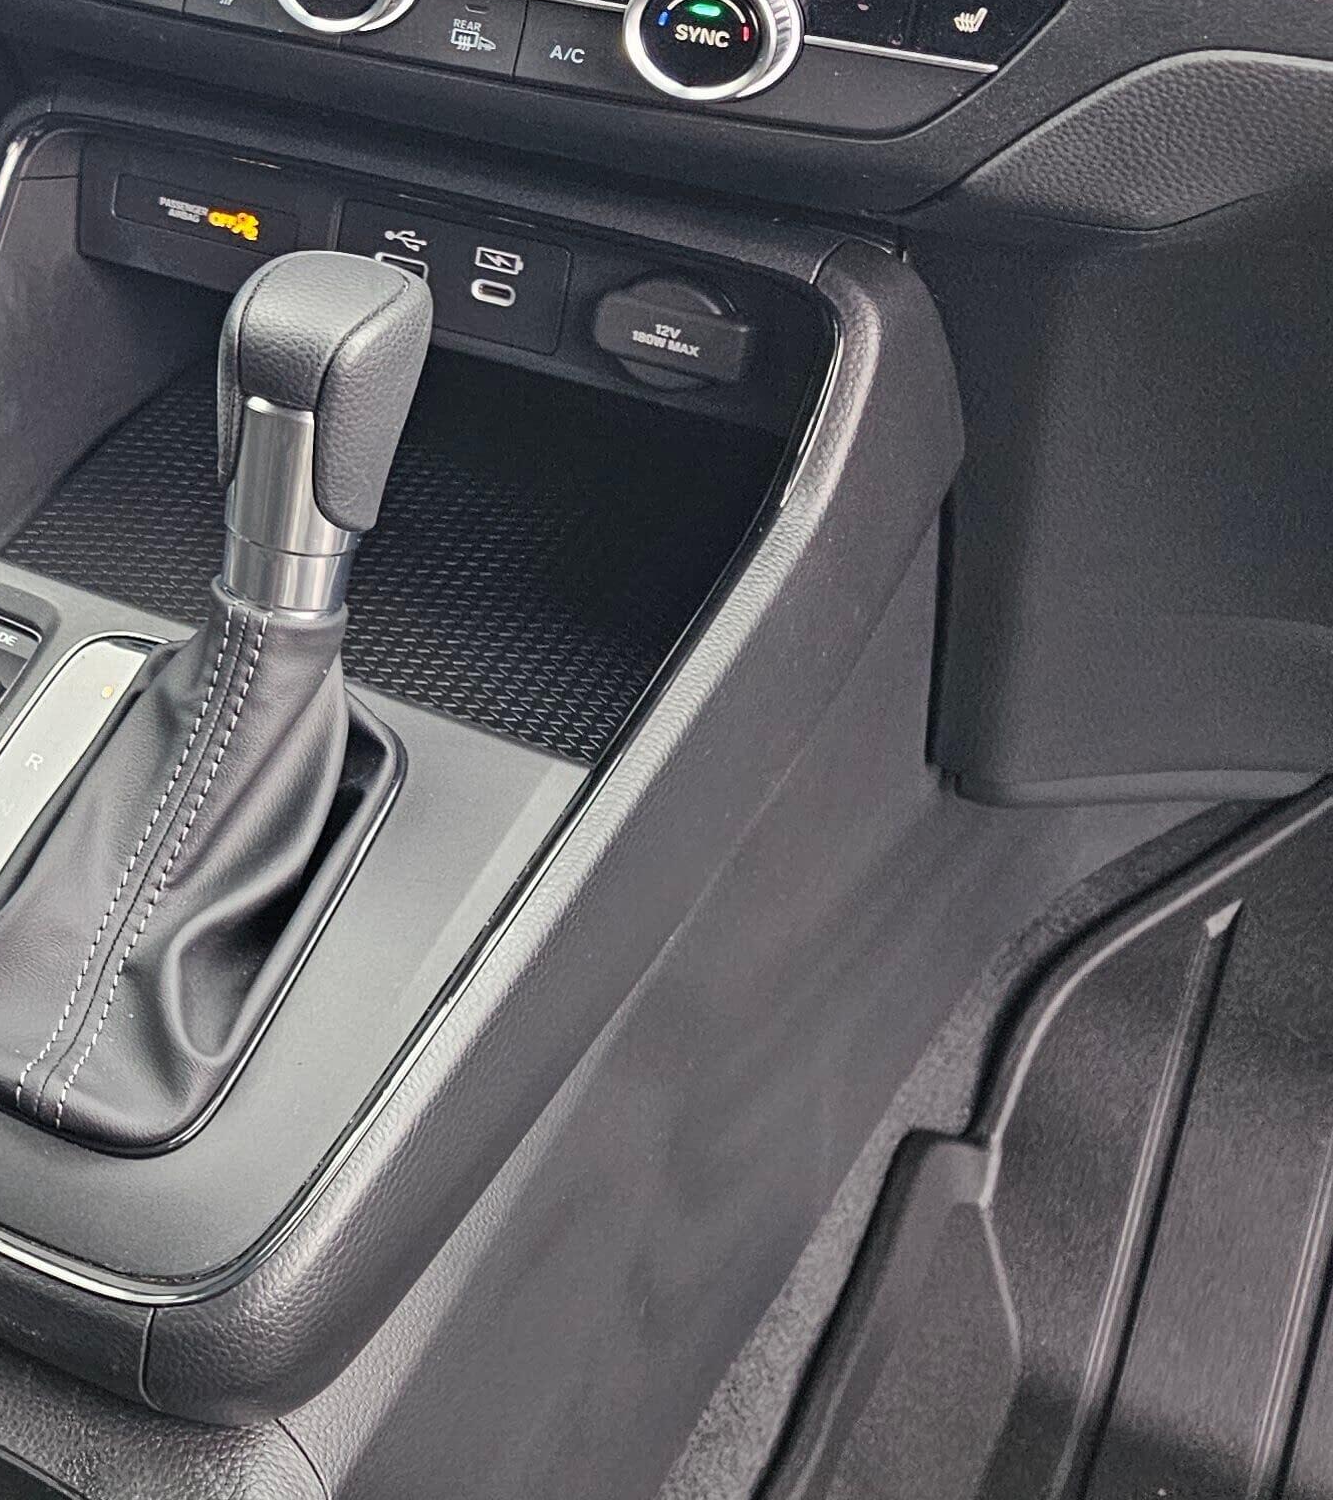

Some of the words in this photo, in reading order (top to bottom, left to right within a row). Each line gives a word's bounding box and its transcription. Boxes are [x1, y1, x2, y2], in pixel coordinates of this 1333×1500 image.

[453, 18, 482, 32] REAR
[674, 23, 731, 48] SYNC
[549, 44, 585, 64] A/C
[655, 323, 681, 339] 12V
[632, 330, 666, 348] 180W
[667, 339, 700, 358] MAX
[25, 753, 44, 771] R
